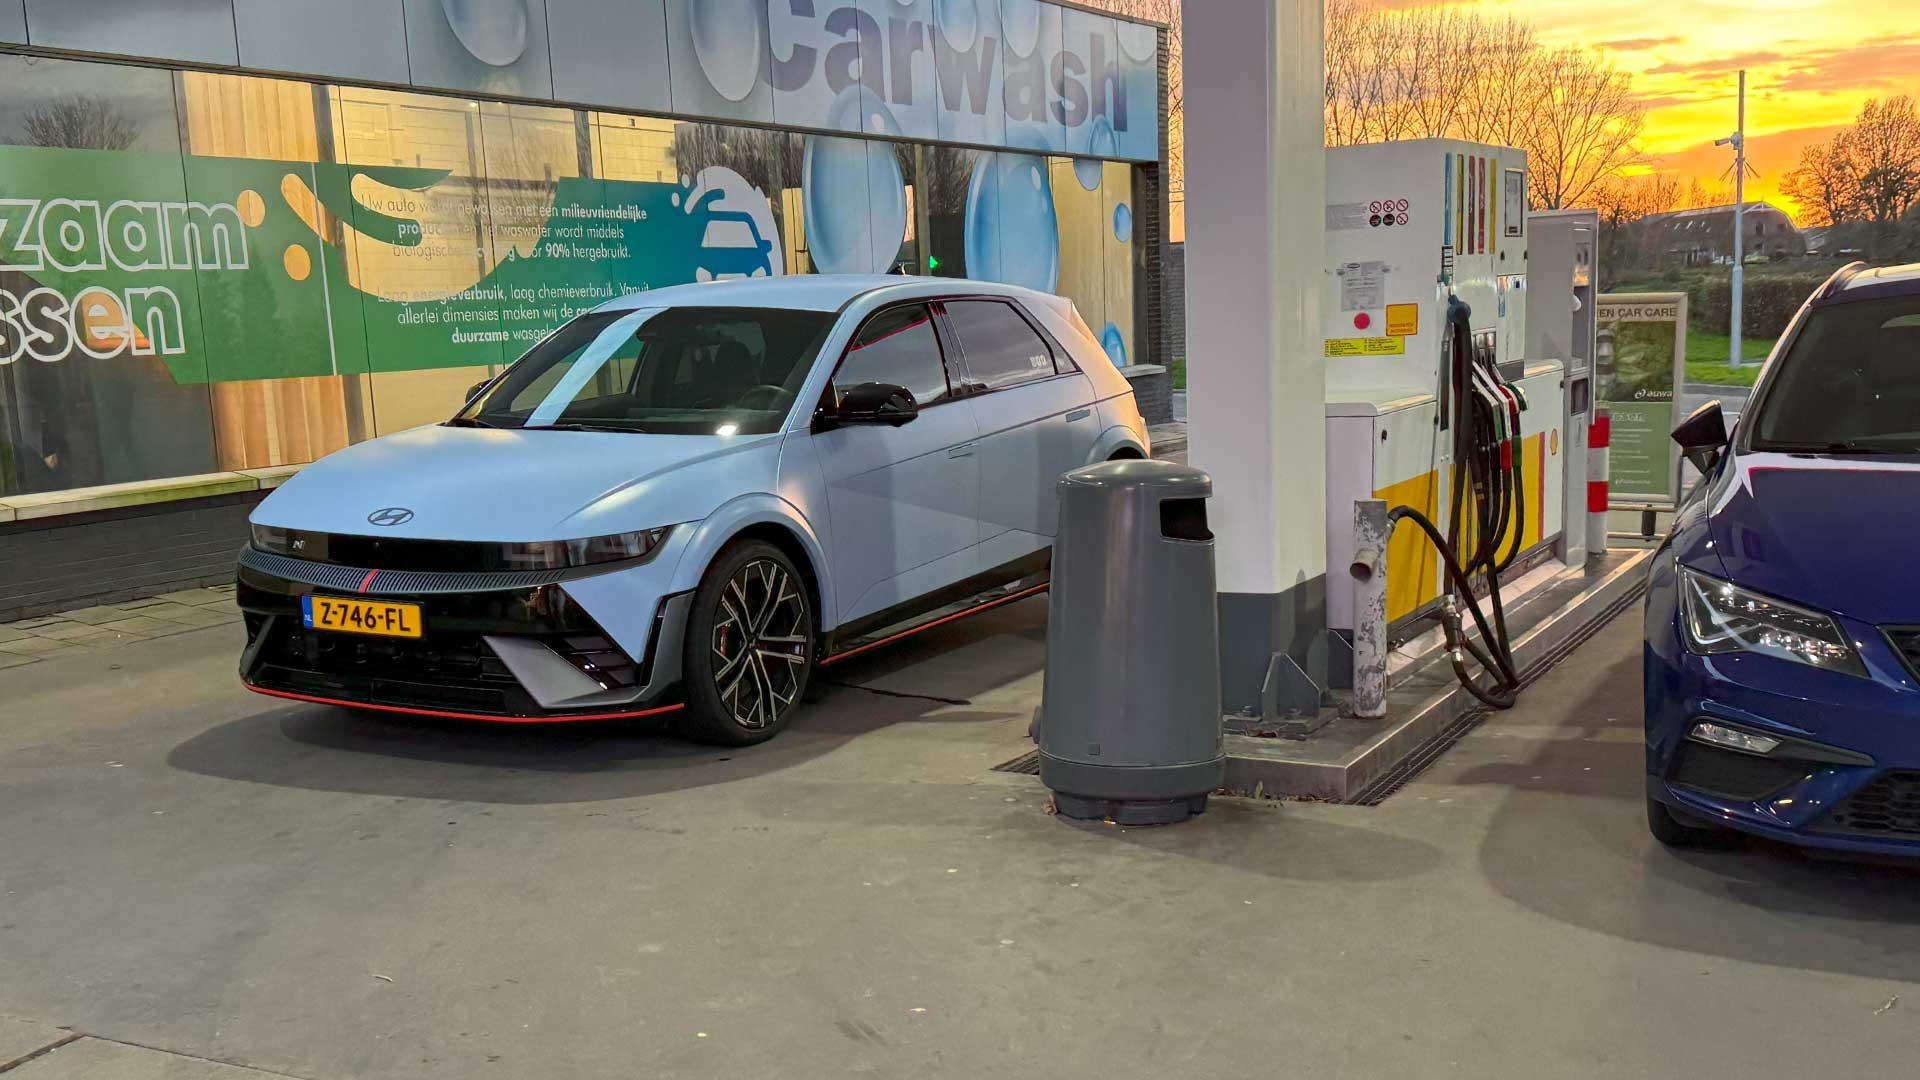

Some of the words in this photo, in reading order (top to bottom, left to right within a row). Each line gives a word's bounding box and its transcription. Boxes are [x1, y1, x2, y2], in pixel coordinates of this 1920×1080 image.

[760, 0, 1127, 132] Carwash
[387, 197, 416, 213] auto
[516, 202, 538, 217] met
[539, 205, 558, 217] een
[561, 203, 647, 223] milieuvriendelijke
[555, 224, 583, 239] wordt
[587, 223, 625, 240] middels
[545, 242, 570, 258] 90%
[572, 243, 632, 262] hergebruikt.
[510, 283, 535, 303] laag
[538, 283, 617, 301] chemieverbruik.
[397, 306, 438, 325] allerlei
[443, 305, 500, 323] dimensies
[502, 304, 540, 321] maken
[543, 304, 558, 322] wij
[560, 303, 574, 319] de
[1617, 307, 1642, 318] CAR
[1644, 307, 1678, 317] CARE
[451, 327, 510, 344] duurzame
[320, 602, 412, 632] Z-746-FL
